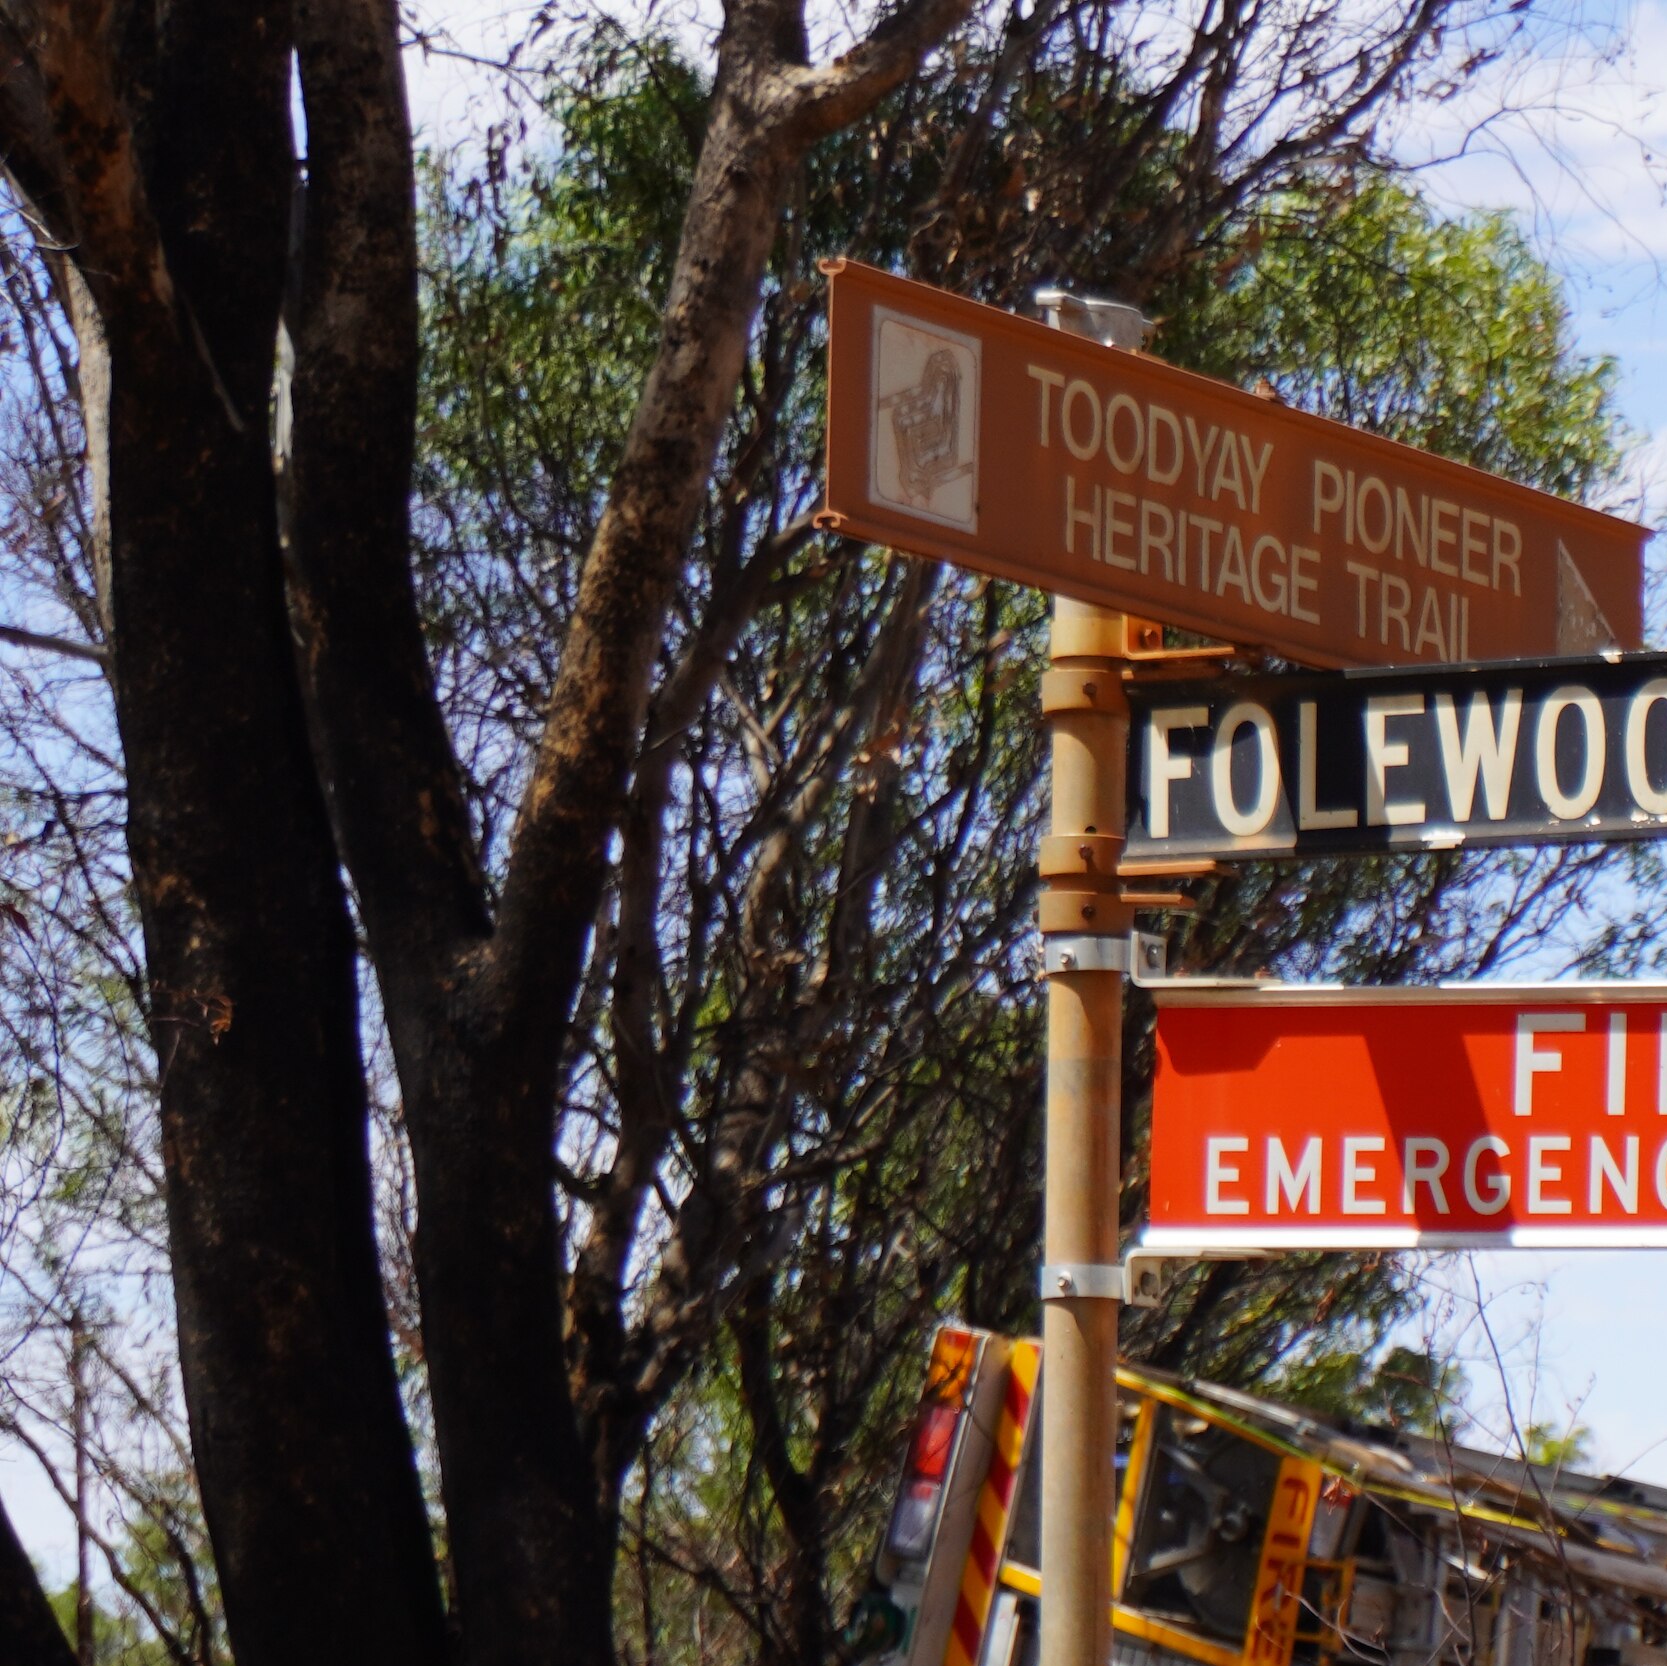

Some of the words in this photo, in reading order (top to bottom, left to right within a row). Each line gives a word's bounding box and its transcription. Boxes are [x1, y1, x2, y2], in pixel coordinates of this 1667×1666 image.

[1028, 365, 1274, 515] TOODYAY
[1314, 460, 1522, 596] PIONEER
[1067, 484, 1321, 626] HERITAGE
[1348, 563, 1475, 663] TRAIL
[1252, 1476, 1310, 1666] FIRE
